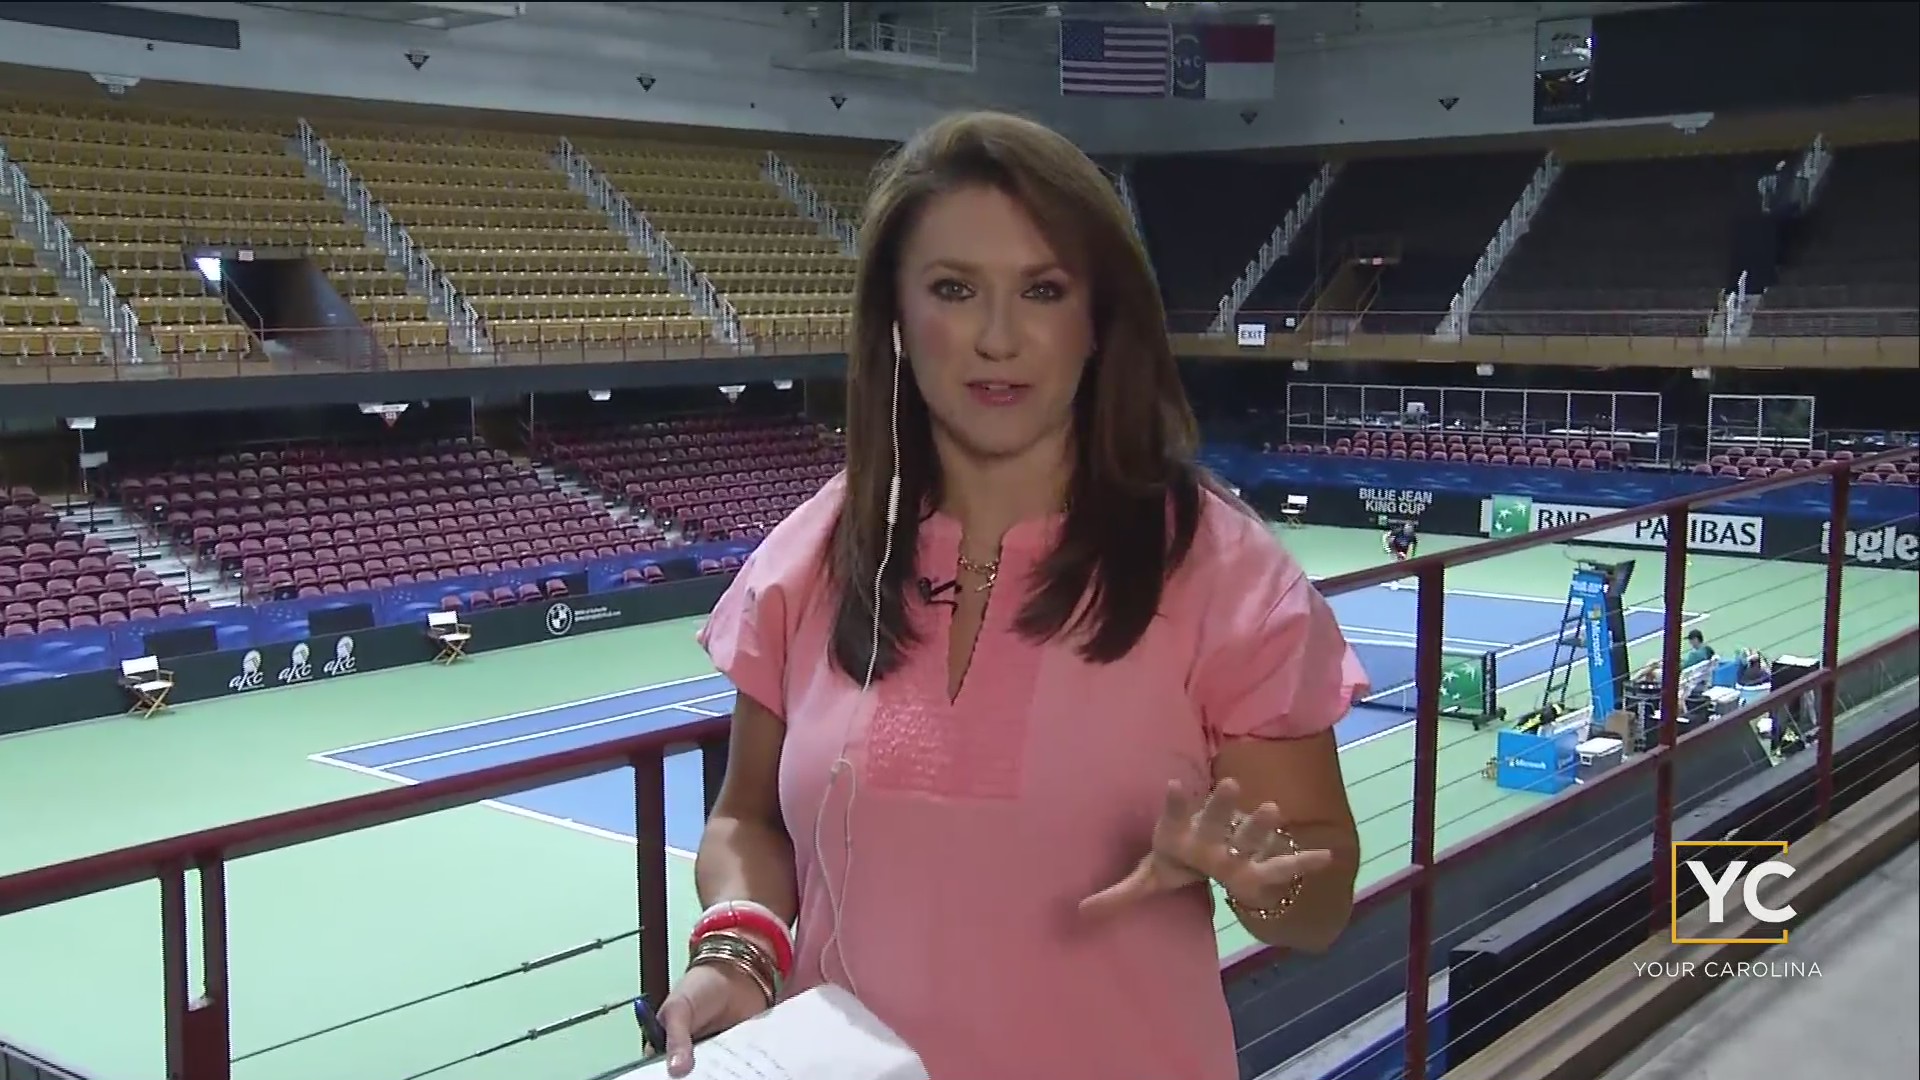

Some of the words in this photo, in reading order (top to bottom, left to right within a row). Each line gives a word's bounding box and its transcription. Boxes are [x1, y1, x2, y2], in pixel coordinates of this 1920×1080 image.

[1240, 330, 1262, 340] EXIT
[1359, 487, 1396, 501] BILLIE
[1398, 489, 1433, 504] JEAN
[1365, 500, 1397, 512] KING
[1399, 502, 1426, 515] CUP
[1635, 516, 1757, 546] PAIBAS
